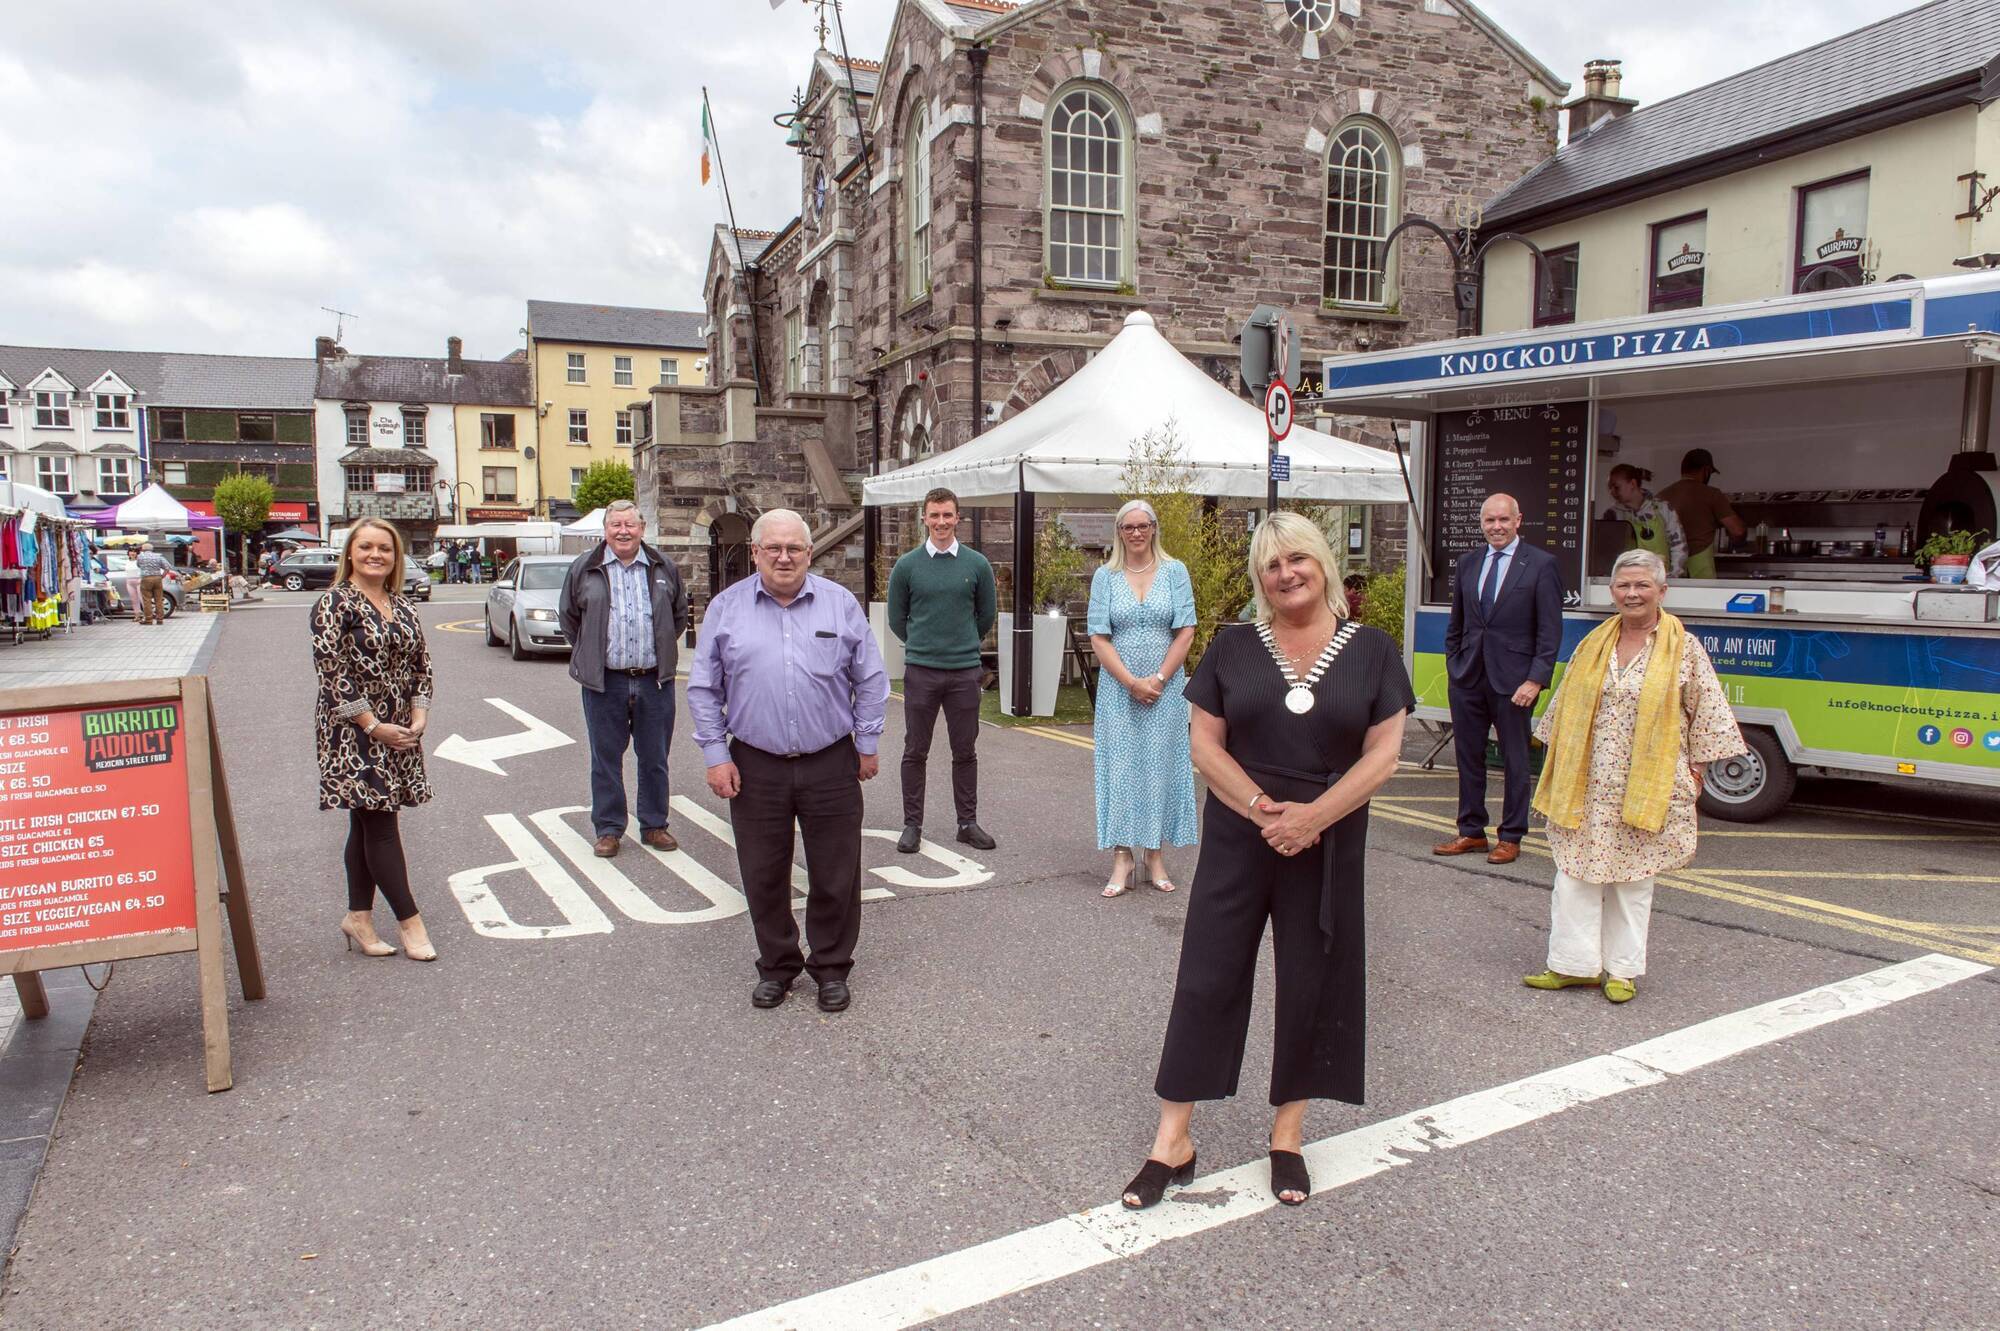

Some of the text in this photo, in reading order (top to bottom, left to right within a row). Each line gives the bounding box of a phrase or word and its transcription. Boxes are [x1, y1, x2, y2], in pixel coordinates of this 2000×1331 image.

[1440, 327, 1711, 377] KNOCKOUT PIZZA
[1275, 392, 1286, 426] P
[1494, 407, 1532, 421] MENU
[1452, 432, 1490, 443] Margherita
[1452, 445, 1487, 456] Pepperoni
[1452, 460, 1474, 469] Cherry
[1476, 459, 1502, 467] Tomato
[1513, 456, 1532, 465] Basil
[1451, 473, 1483, 481] Hawaiian
[1466, 487, 1486, 495] Vegan
[1450, 500, 1468, 508] Meat
[1450, 513, 1468, 522] Spicy
[1703, 636, 1776, 656] FOR ANY EVENT
[1741, 660, 1773, 668] ovens
[1828, 698, 2000, 721] info@knockoutpizza.i
[17, 715, 49, 729] IRISH
[85, 707, 176, 736] BURRITO
[9, 732, 49, 746] €8.50
[90, 729, 168, 760] ADDICT
[15, 747, 58, 758] GUACAMOLE
[0, 761, 26, 774] SIZE
[95, 753, 167, 770] MEXICAN STREET FOOD
[10, 775, 51, 790] €6.50
[11, 791, 32, 800] FRESH
[35, 786, 79, 798] GUACAMOLE
[81, 784, 107, 794] €0.50
[30, 814, 63, 828] IRISH
[67, 808, 117, 825] CHICKEN
[121, 804, 160, 818] €7.50
[17, 828, 61, 841] GUACAMOLE
[2, 835, 104, 857] SIZE CHICKEN €5
[17, 857, 39, 867] FRESH
[42, 852, 85, 864] GUACAMOLE
[88, 848, 114, 859] €0.50
[61, 875, 113, 892] BURRITO
[117, 870, 157, 885] €6.50
[19, 899, 41, 909] FRESH
[44, 893, 89, 906] GUACAMOLE
[3, 895, 165, 926] SIZE VEGGIE/VEGAN €4.50
[20, 925, 43, 935] FRESH
[45, 920, 90, 932] GUACAMOLE
